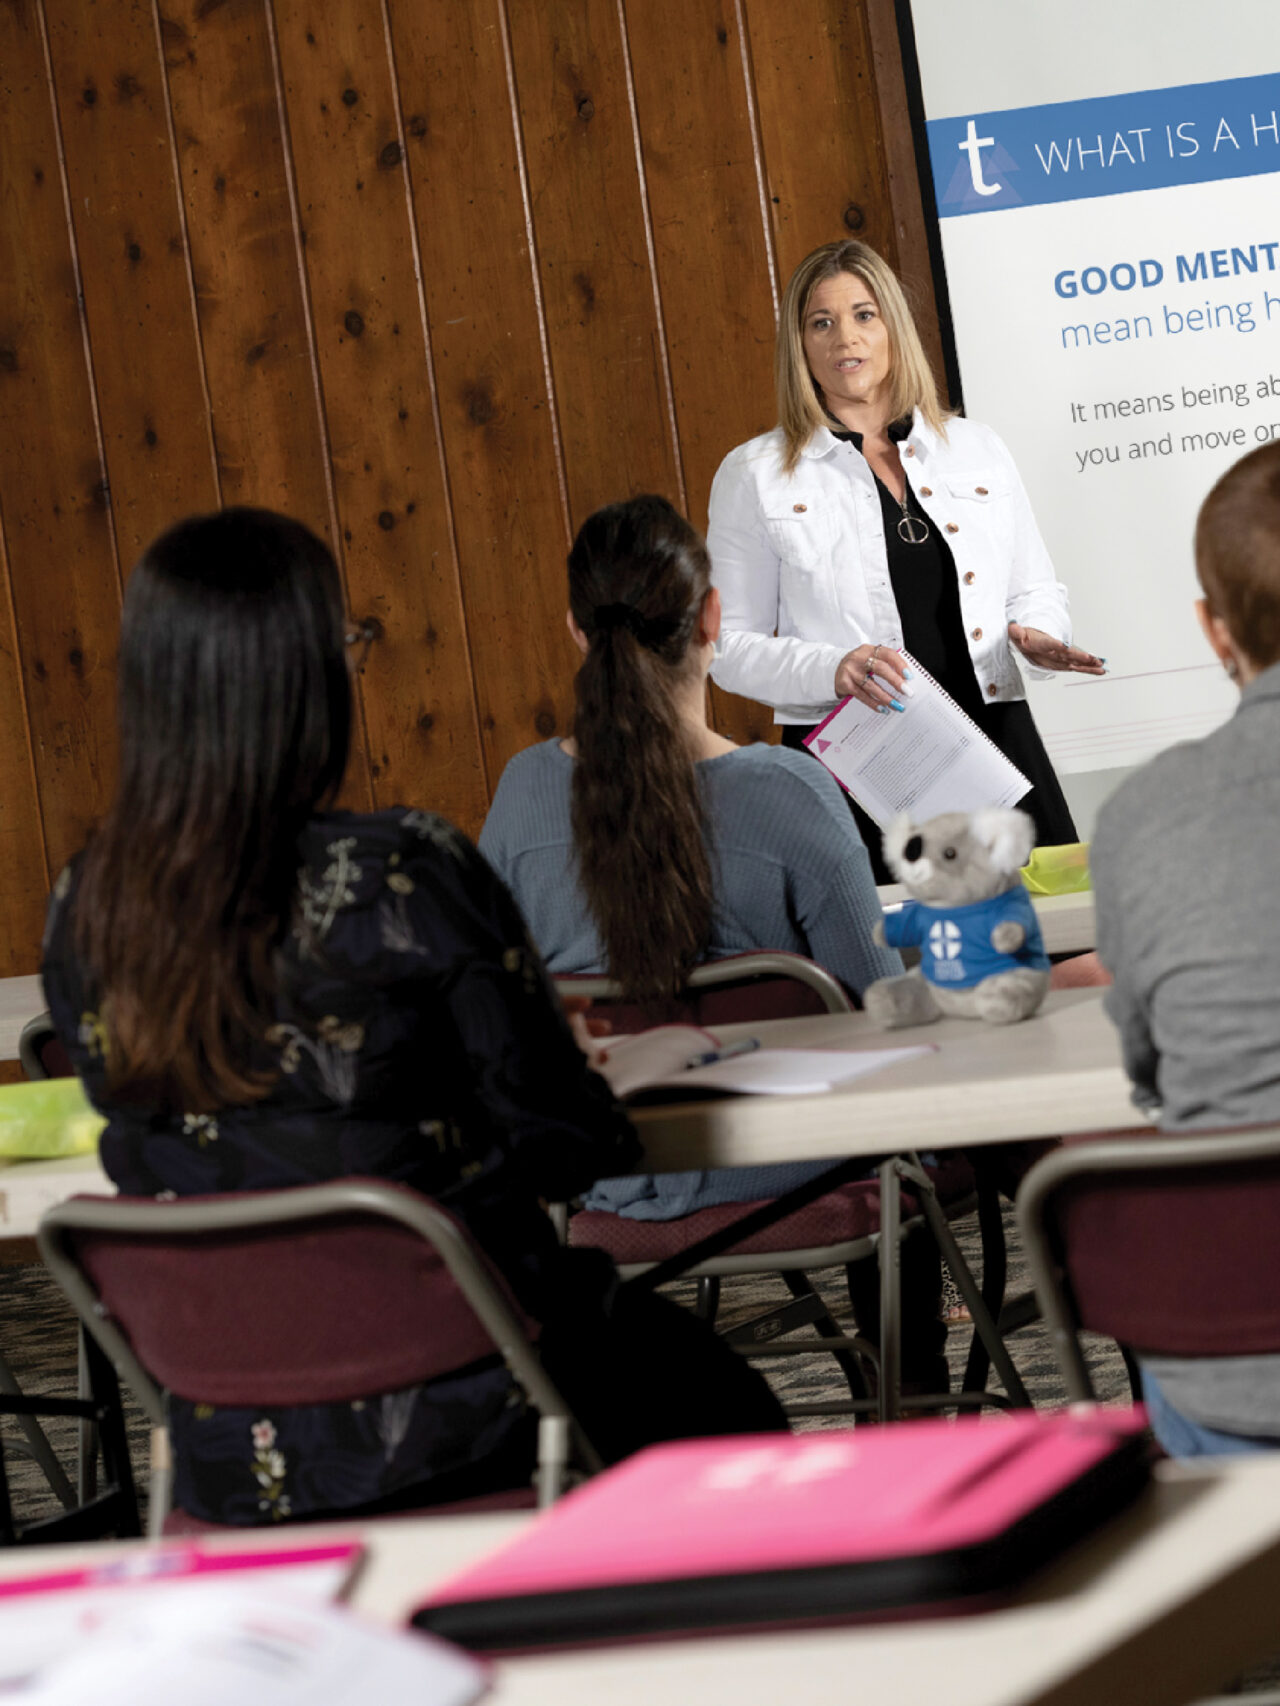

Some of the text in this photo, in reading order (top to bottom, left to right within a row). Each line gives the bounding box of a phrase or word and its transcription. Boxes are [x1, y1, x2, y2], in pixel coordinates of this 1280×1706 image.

[958, 119, 1002, 196] t
[1032, 127, 1152, 175] WHAT
[1165, 122, 1200, 159] IS
[1212, 117, 1240, 152] A
[1054, 258, 1164, 299] GOOD
[1061, 316, 1153, 349] mean
[1162, 301, 1257, 335] being
[1070, 402, 1088, 424] It
[1093, 393, 1176, 421] means
[1181, 383, 1250, 409] being
[1075, 445, 1121, 473] you
[1128, 431, 1173, 460] and
[1181, 428, 1246, 453] move
